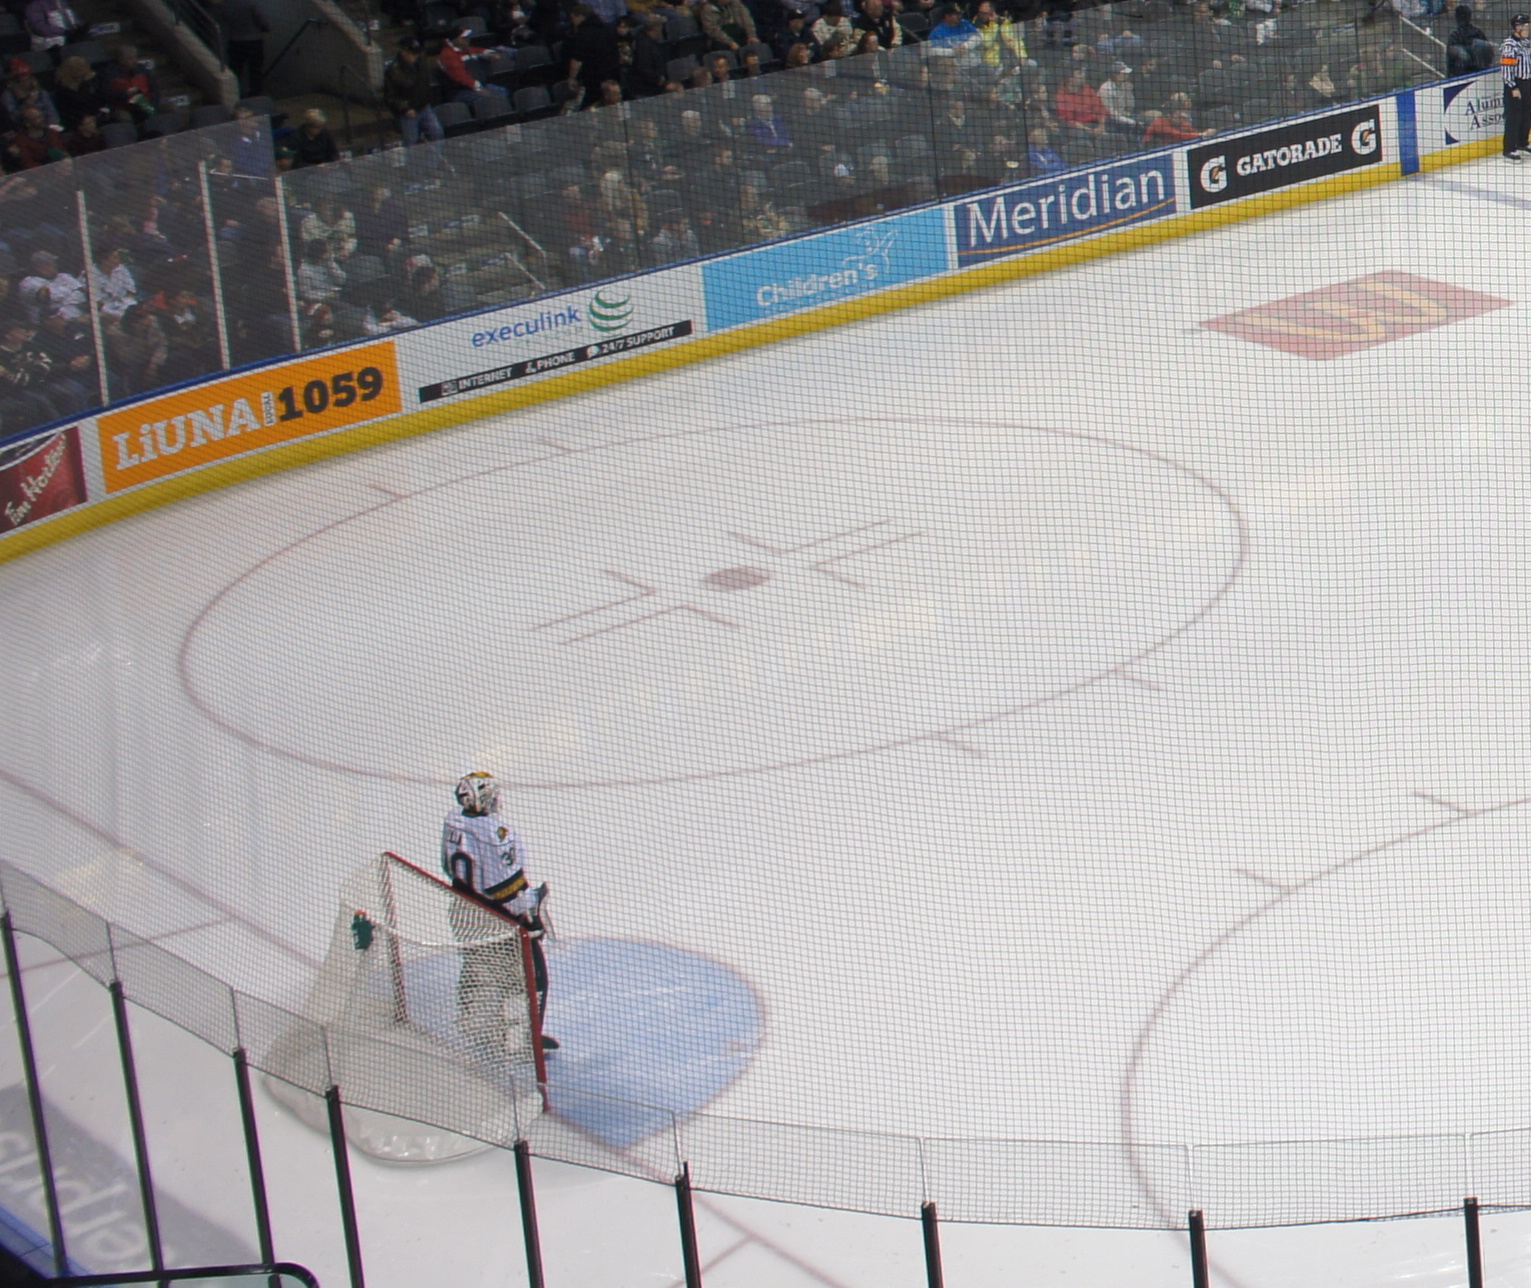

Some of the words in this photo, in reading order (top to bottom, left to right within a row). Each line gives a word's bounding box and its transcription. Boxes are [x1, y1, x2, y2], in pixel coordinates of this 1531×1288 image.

[1236, 133, 1343, 177] GATORADE
[1351, 118, 1377, 155] G
[966, 168, 1166, 249] Meridian
[757, 260, 878, 309] Children's
[471, 304, 582, 349] execulink
[626, 325, 676, 349] SUPPORT
[458, 365, 513, 390] INTERNET
[536, 350, 576, 372] PHONE
[113, 396, 262, 472] LiUNA
[278, 365, 383, 422] 1059
